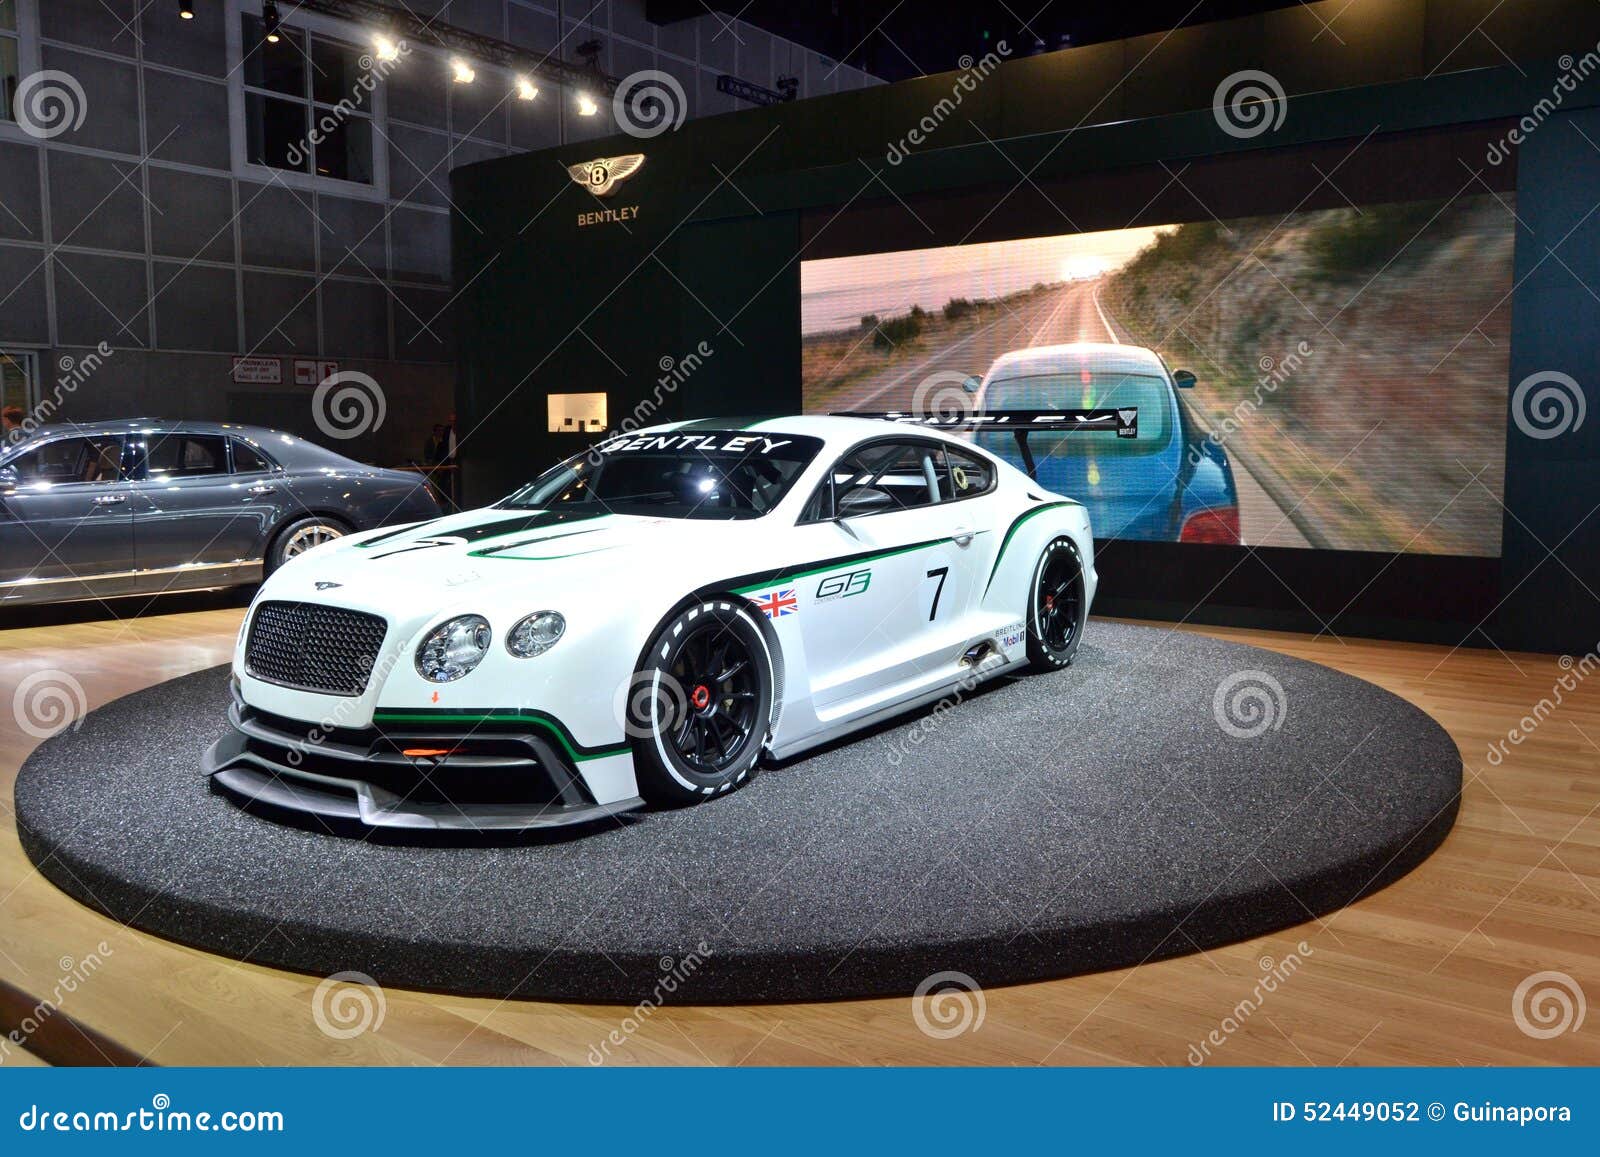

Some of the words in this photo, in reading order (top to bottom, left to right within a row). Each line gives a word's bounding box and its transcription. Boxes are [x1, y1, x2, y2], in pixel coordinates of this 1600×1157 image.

[577, 206, 639, 226] BENTLEY
[600, 435, 792, 454] BENTLEY
[816, 568, 872, 599] GT3
[927, 566, 949, 622] 7
